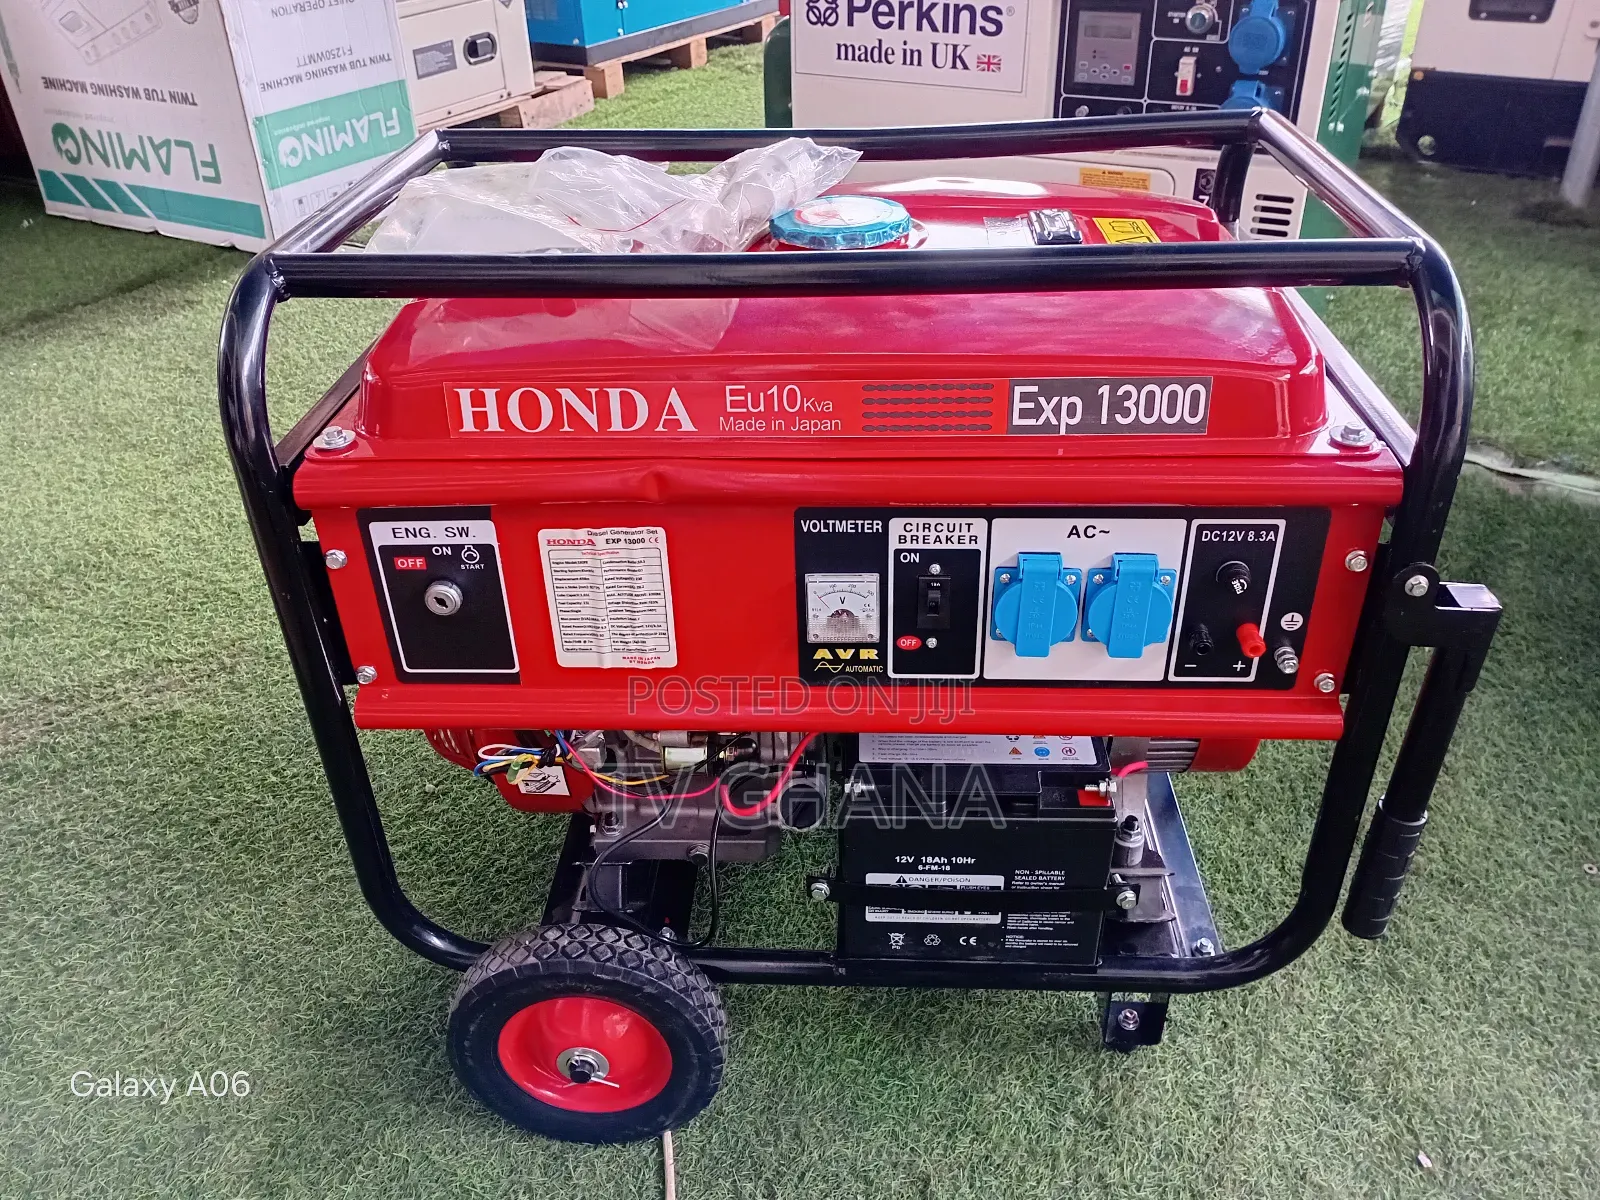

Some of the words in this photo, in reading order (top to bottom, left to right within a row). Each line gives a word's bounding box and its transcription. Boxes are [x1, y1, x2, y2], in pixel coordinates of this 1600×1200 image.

[846, 0, 1004, 37] Perkins
[297, 45, 354, 67] F1250WMTT
[369, 52, 392, 65] TWIN
[835, 38, 896, 65] made
[901, 40, 923, 67] in
[930, 42, 972, 71] UK
[349, 56, 367, 67] TUB
[306, 62, 348, 81] WASHING
[40, 76, 89, 94] MACHINE
[260, 75, 303, 92] MACHINE
[91, 82, 145, 100] WASHING
[143, 88, 168, 103] TUB
[168, 90, 199, 106] TWIN
[453, 386, 698, 433] HONDA
[1012, 385, 1083, 435] Exp
[1097, 383, 1207, 425] 13000
[718, 416, 767, 432] Made
[770, 416, 785, 432] in
[790, 417, 842, 434] Japan
[391, 527, 437, 539] ENG.
[444, 526, 476, 538] SW.
[800, 519, 883, 533] VOLTMETER
[903, 522, 974, 533] CIRCUIT
[546, 538, 597, 546] HONDA
[624, 537, 646, 545] 13000
[898, 534, 979, 545] BREAKER
[1201, 530, 1245, 542] DC12V
[1247, 530, 1276, 542] 8.3A
[432, 546, 452, 556] ON
[900, 552, 920, 563] ON
[397, 558, 424, 568] OFF
[839, 597, 846, 605] V
[900, 638, 917, 647] OFF
[812, 648, 880, 660] AVR
[845, 665, 884, 673] AUTOMATIC
[920, 856, 948, 864] 18Ah
